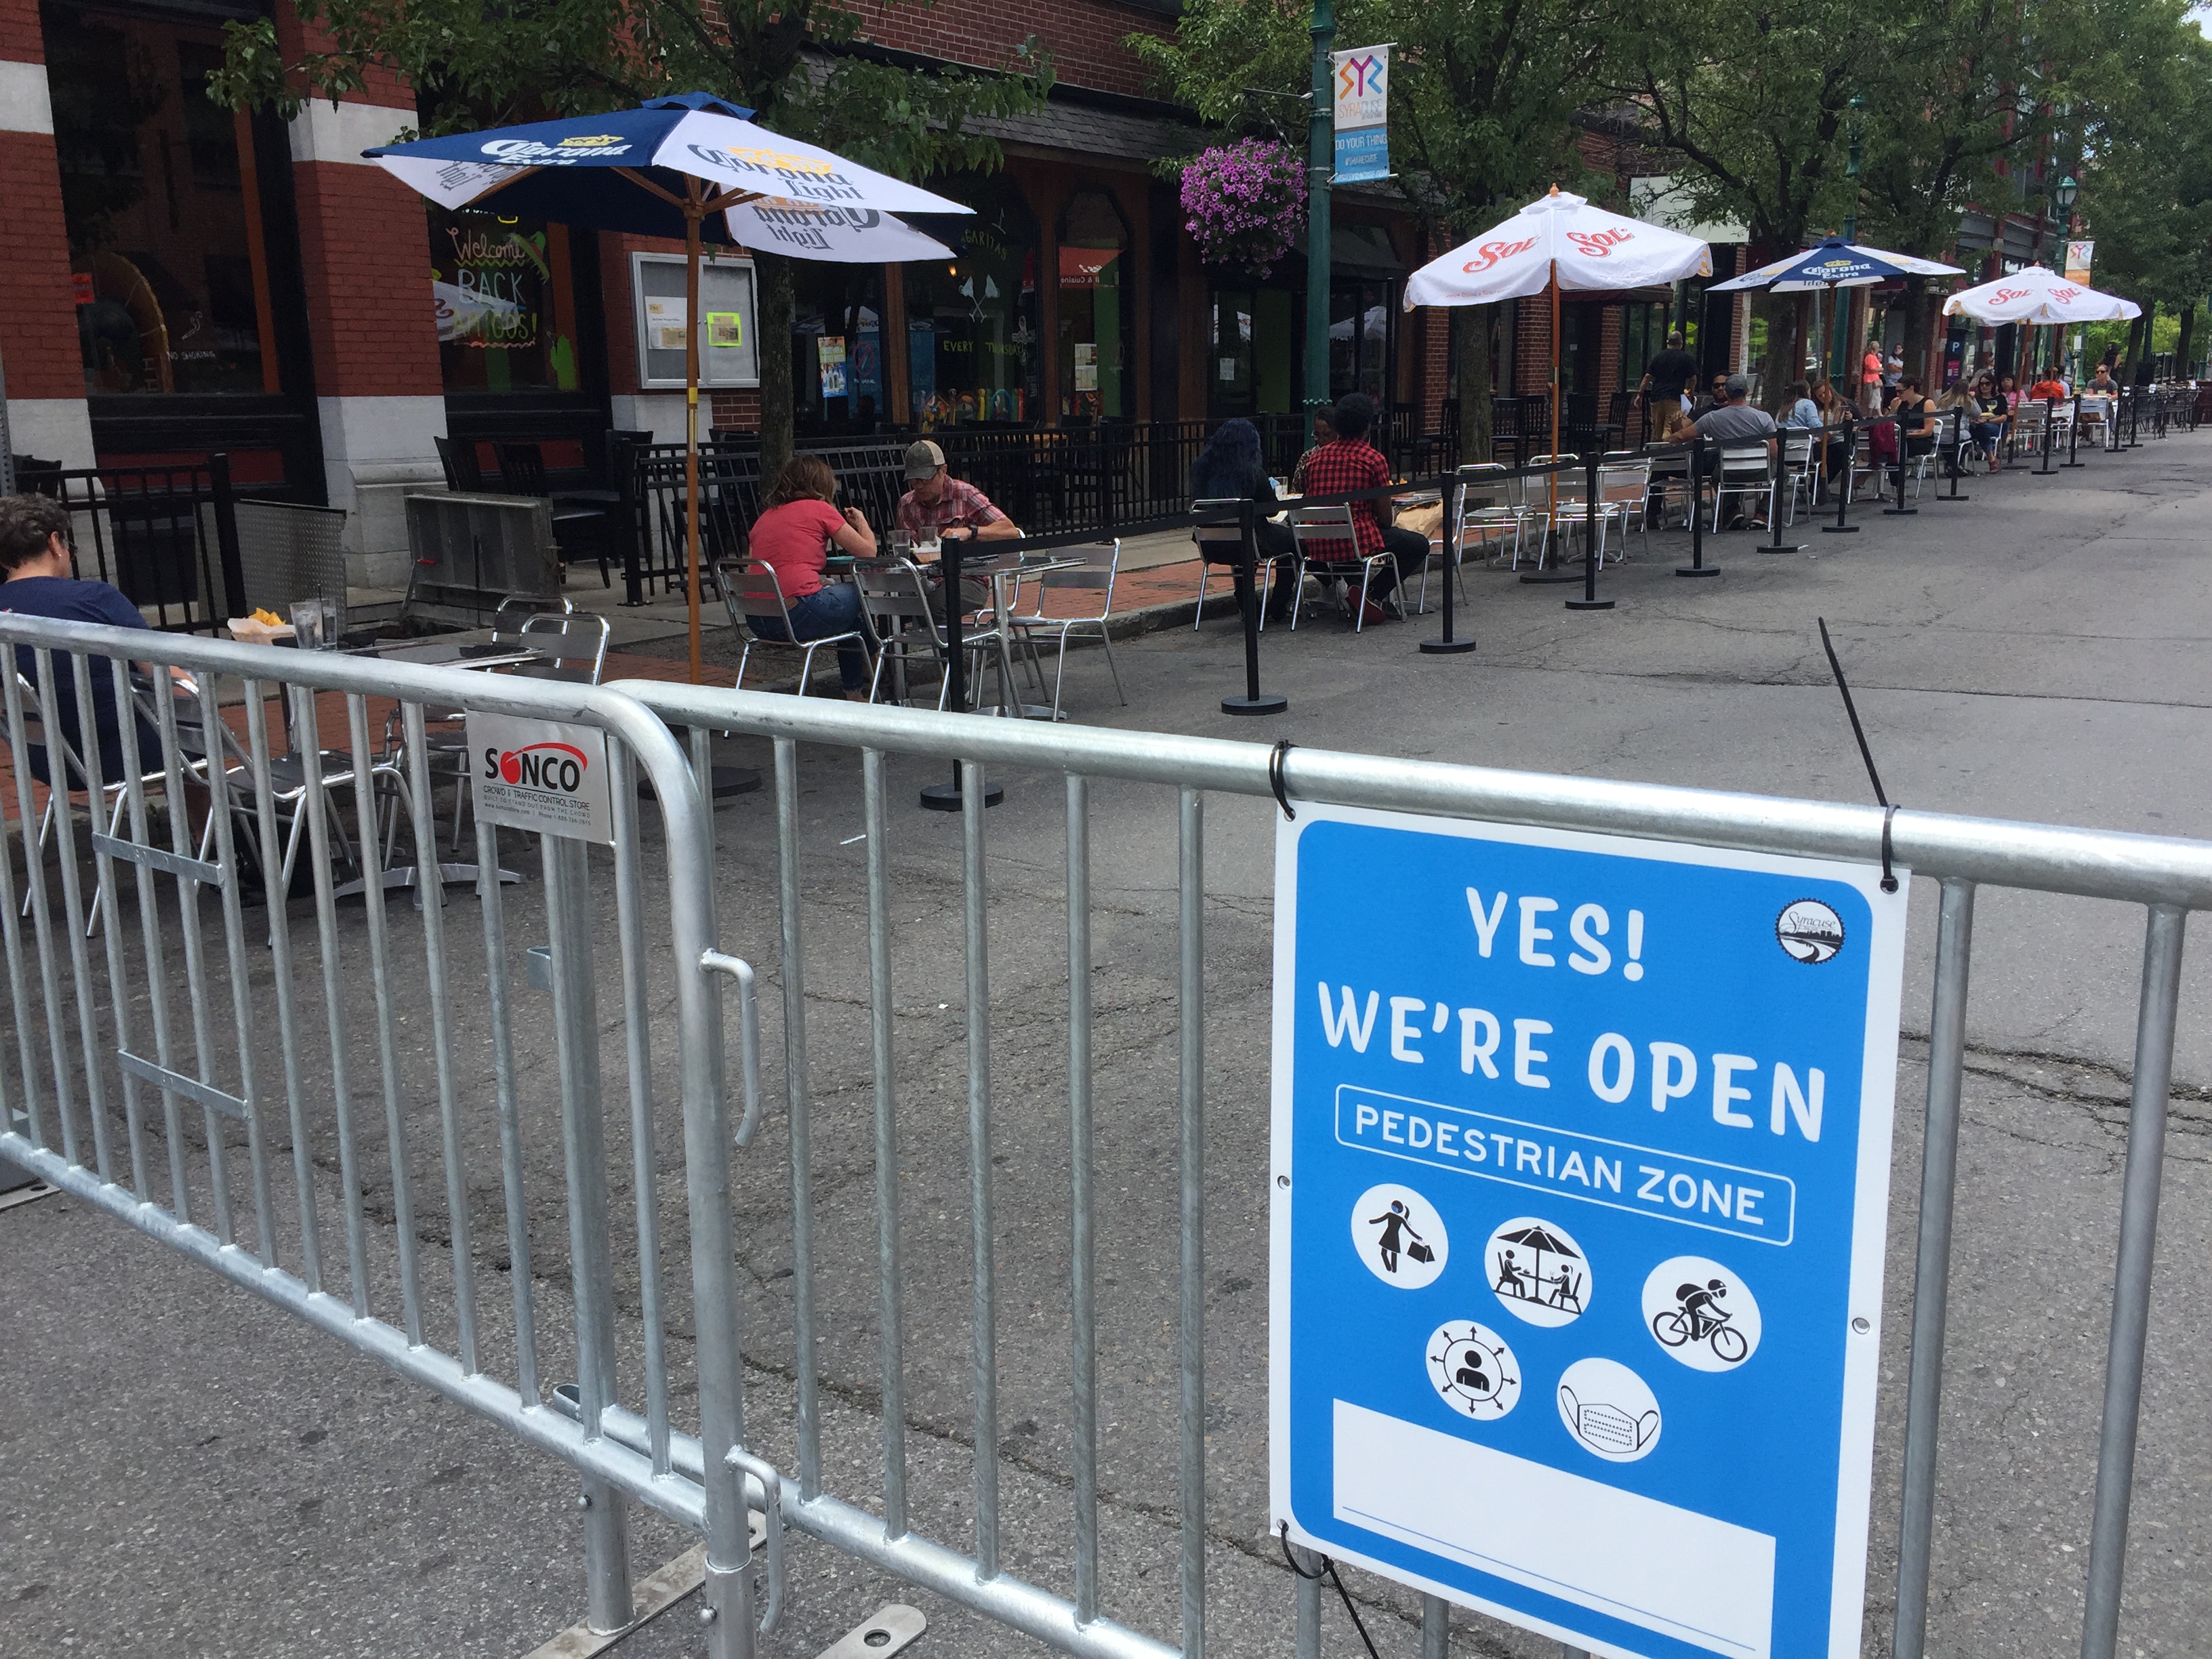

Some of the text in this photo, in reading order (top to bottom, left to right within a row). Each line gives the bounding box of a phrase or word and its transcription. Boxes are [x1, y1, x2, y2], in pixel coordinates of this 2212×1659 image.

[1339, 54, 1384, 100] SYR
[1338, 99, 1382, 119] SYRACUSE
[480, 140, 633, 158] Corona
[1336, 134, 1387, 150] DO YOUR THING
[687, 144, 853, 186] Corona
[1345, 154, 1377, 166] #SHARECUSE
[781, 178, 866, 202] Light
[445, 227, 526, 260] Welcome
[1802, 263, 1871, 275] Corona
[1822, 271, 1859, 280] Extra
[457, 268, 527, 305] BACK
[452, 307, 538, 340] AMIGOS!
[167, 350, 216, 362] NO SMOKING
[943, 340, 974, 352] EVERY
[1952, 342, 1960, 352] P
[485, 747, 580, 792] SONCO
[483, 785, 506, 796] CROWD
[513, 790, 538, 802] TRAFFIC
[538, 795, 569, 807] CONTROL
[569, 800, 590, 811] STORE
[1466, 886, 1644, 981] YES!
[1788, 911, 1836, 933] Syracuse
[1318, 981, 1825, 1143] WE'RE OPEN
[1355, 1104, 1764, 1225] PEDESTRIAN ZONE
